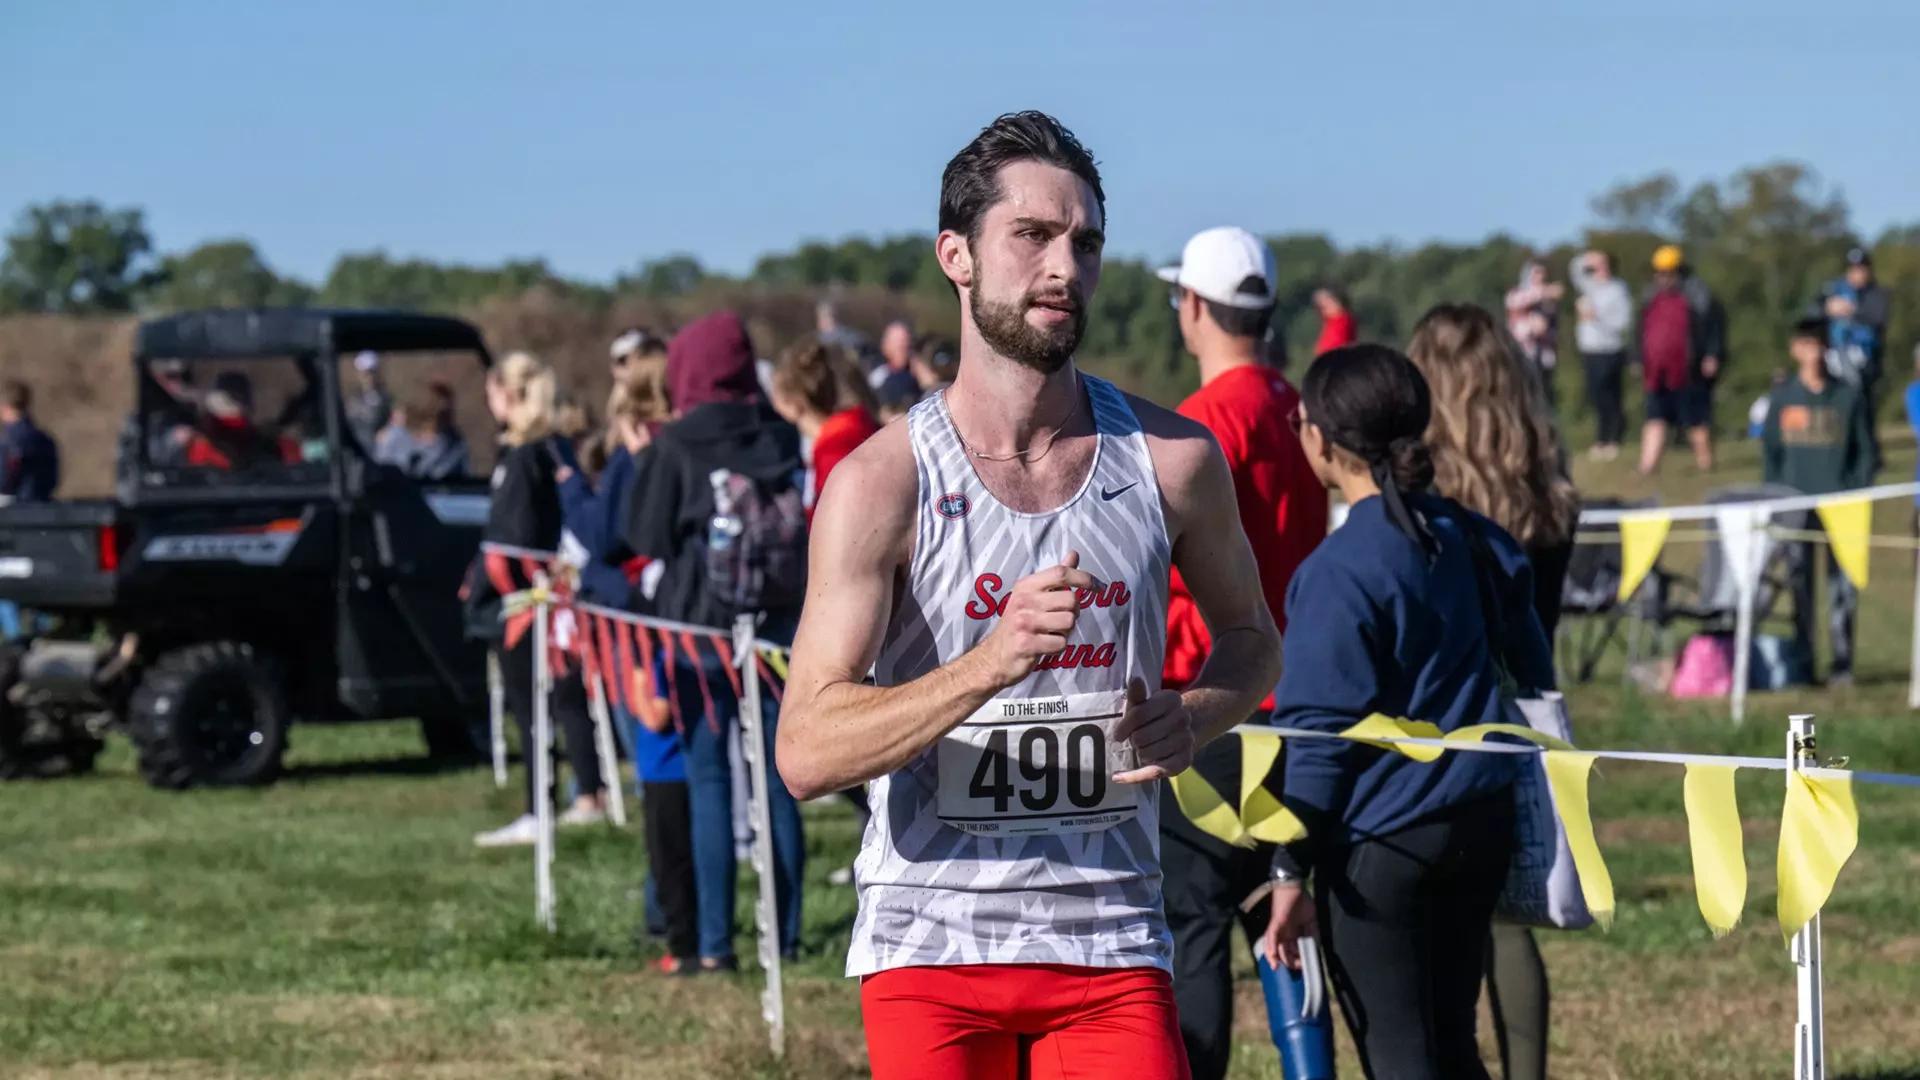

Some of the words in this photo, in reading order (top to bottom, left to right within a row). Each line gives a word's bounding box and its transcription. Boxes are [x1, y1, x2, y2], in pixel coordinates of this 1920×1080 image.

[1002, 704, 1015, 716] TO
[1017, 703, 1036, 716] THE
[1038, 700, 1069, 715] FINISH
[969, 723, 1107, 813] 490
[967, 824, 978, 832] THE
[979, 823, 1000, 832] FINISH
